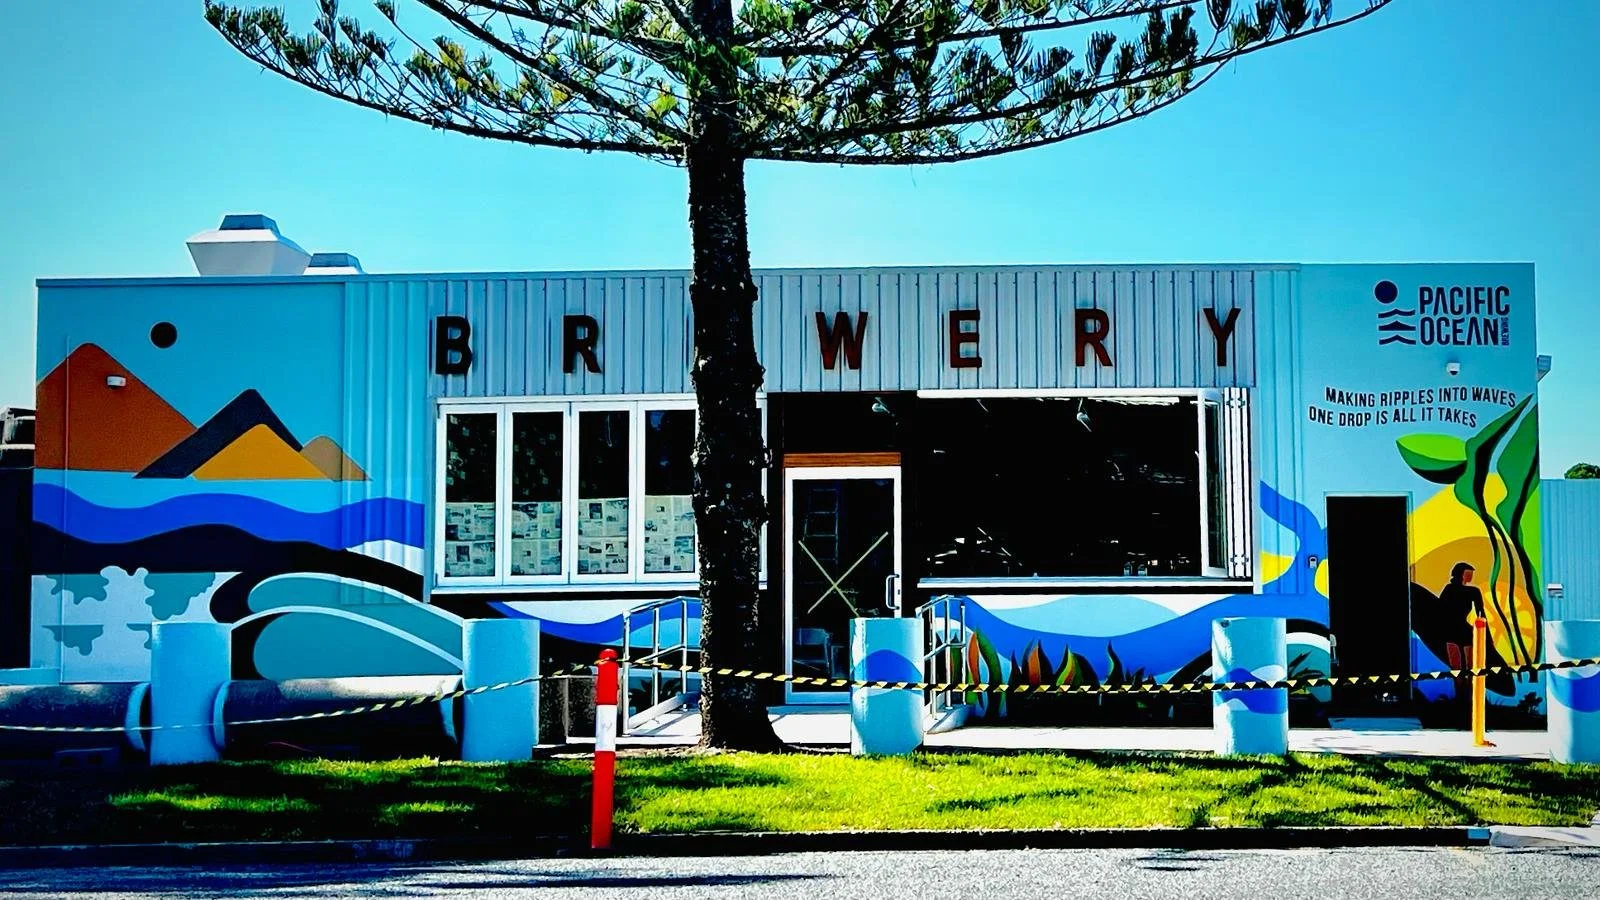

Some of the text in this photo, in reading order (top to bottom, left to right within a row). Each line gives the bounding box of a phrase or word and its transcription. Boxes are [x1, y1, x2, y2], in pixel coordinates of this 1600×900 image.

[1419, 286, 1510, 316] PACIFIC
[434, 307, 1241, 375] BRWERY
[1420, 317, 1499, 346] OCEAN
[1325, 386, 1516, 408] MAKING RIPPLES INTO WAVES
[1309, 406, 1477, 428] ONE DROP IS ALL IT TAKES
